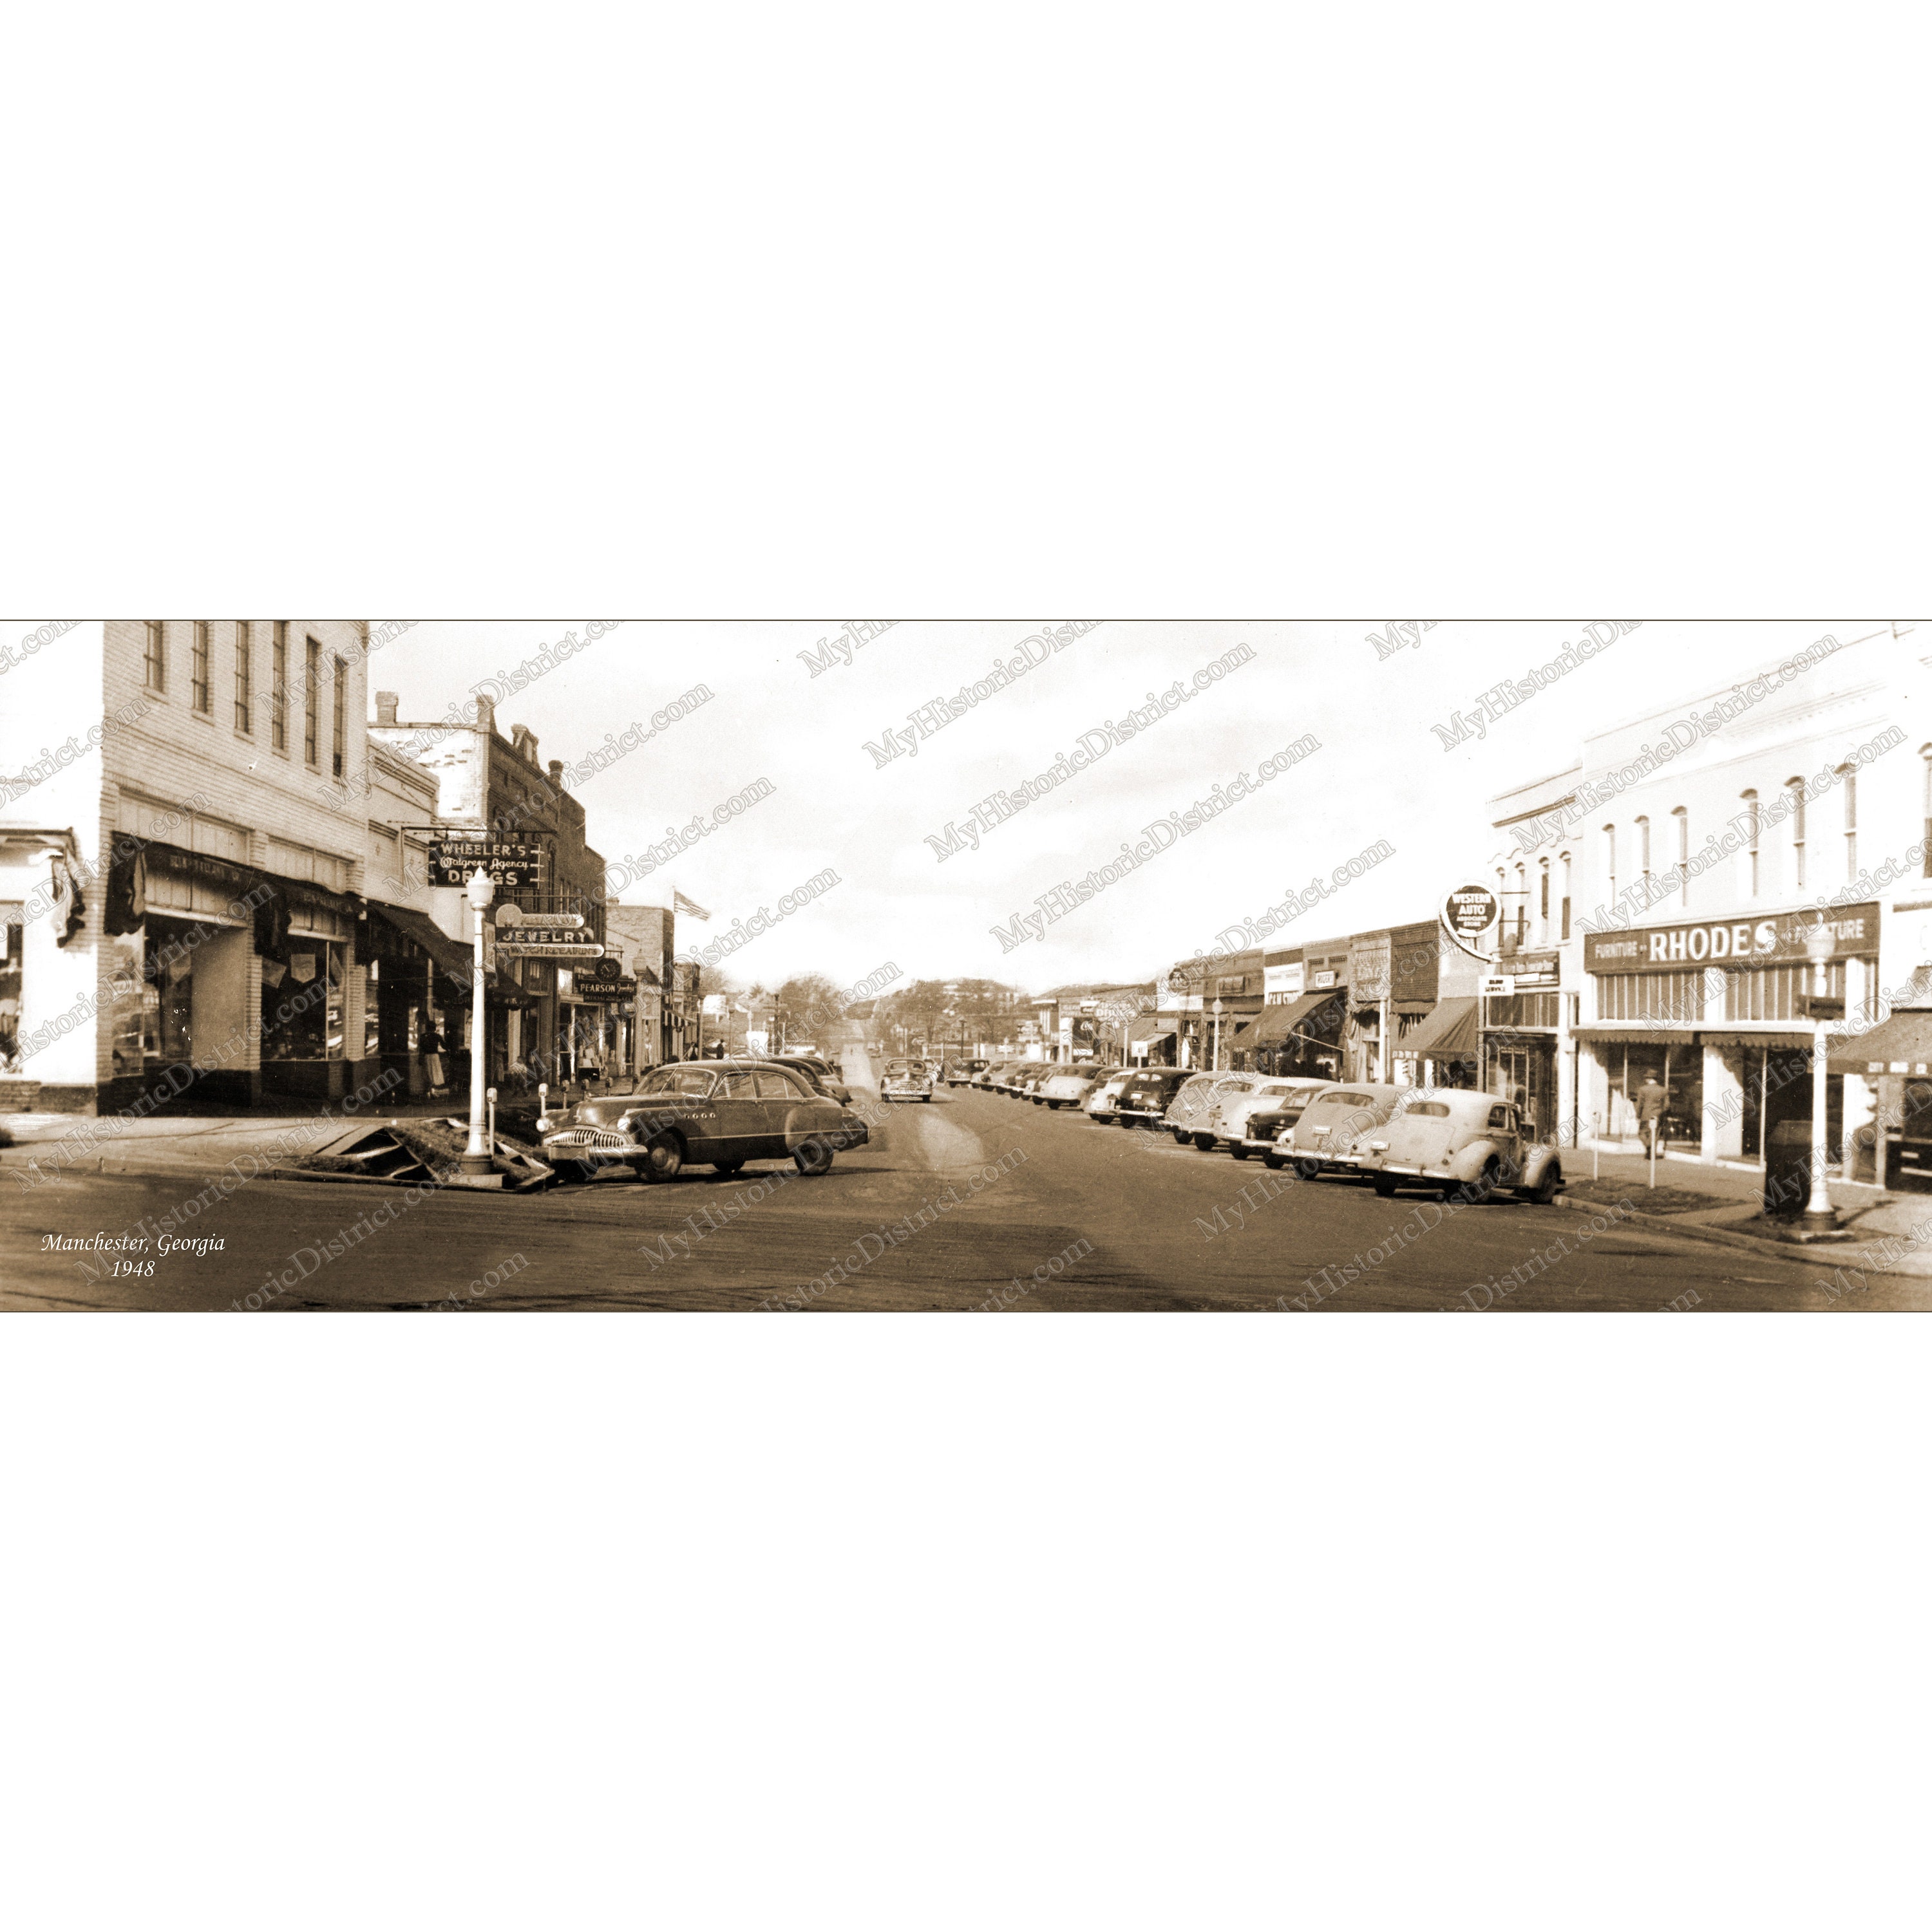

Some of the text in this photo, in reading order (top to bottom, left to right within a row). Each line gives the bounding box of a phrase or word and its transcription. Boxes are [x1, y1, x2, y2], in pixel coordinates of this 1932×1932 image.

[440, 844, 526, 857] WHEELER'S
[440, 857, 528, 870] Walgreen Agency
[448, 870, 518, 886] DRGS
[1452, 893, 1491, 904] WESTERN
[1459, 904, 1486, 915] AUTO
[502, 931, 587, 943] JEWELRY
[1595, 941, 1638, 959] FURNITURE
[1649, 921, 1776, 961] RHODES
[580, 983, 615, 992] PEARSON
